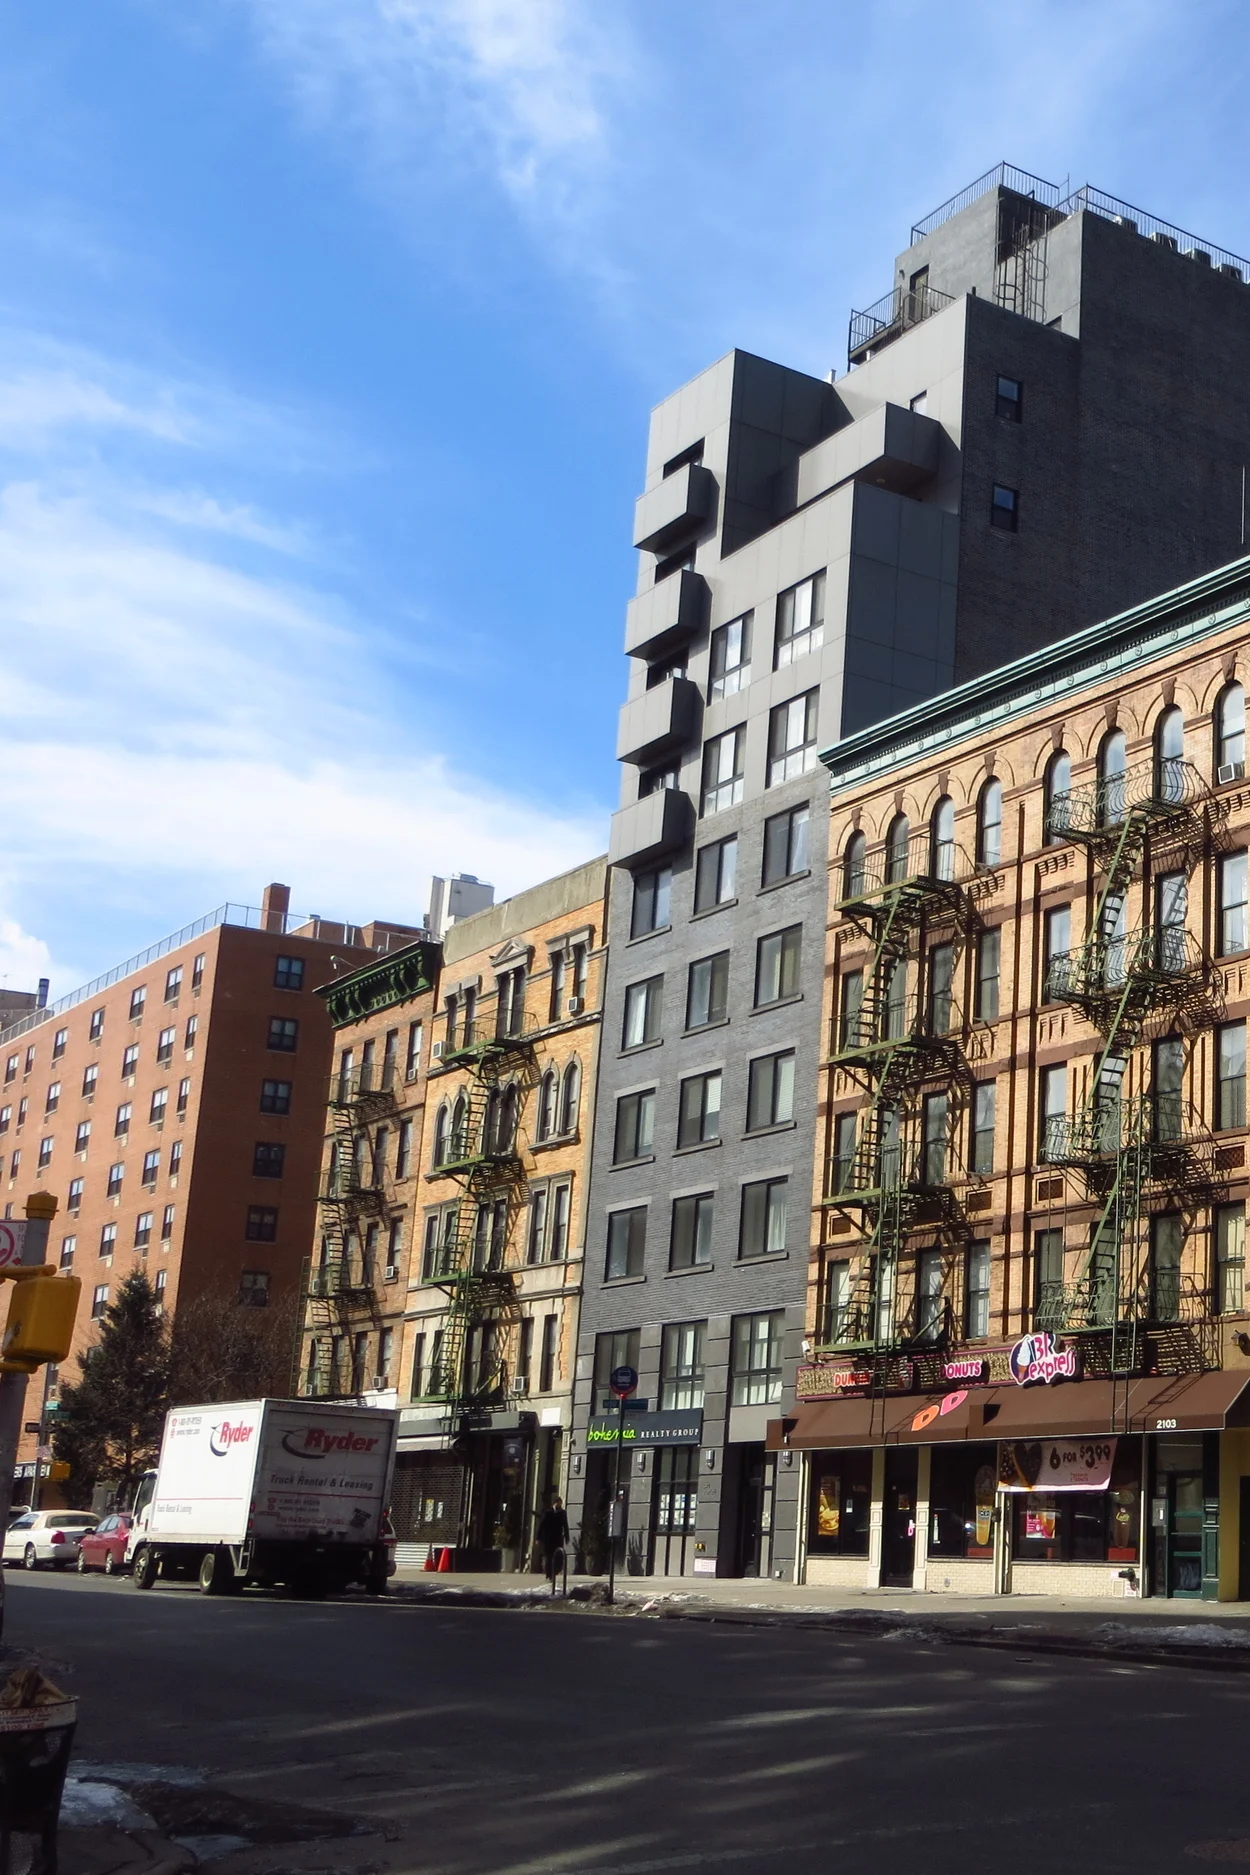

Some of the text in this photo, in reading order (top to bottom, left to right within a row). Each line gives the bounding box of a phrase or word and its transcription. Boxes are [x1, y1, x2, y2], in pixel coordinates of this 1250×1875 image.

[941, 1361, 982, 1380] DONUTS
[1029, 1349, 1076, 1381] express
[640, 1429, 670, 1438] REALTY
[673, 1428, 699, 1437] GROUP
[1156, 1418, 1177, 1429] 2103
[219, 1420, 254, 1449] Ryder
[304, 1427, 380, 1453] Ryder
[1050, 1447, 1061, 1470] 6
[1062, 1451, 1077, 1463] FOR
[270, 1474, 374, 1491] Truck Rental & Leasing
